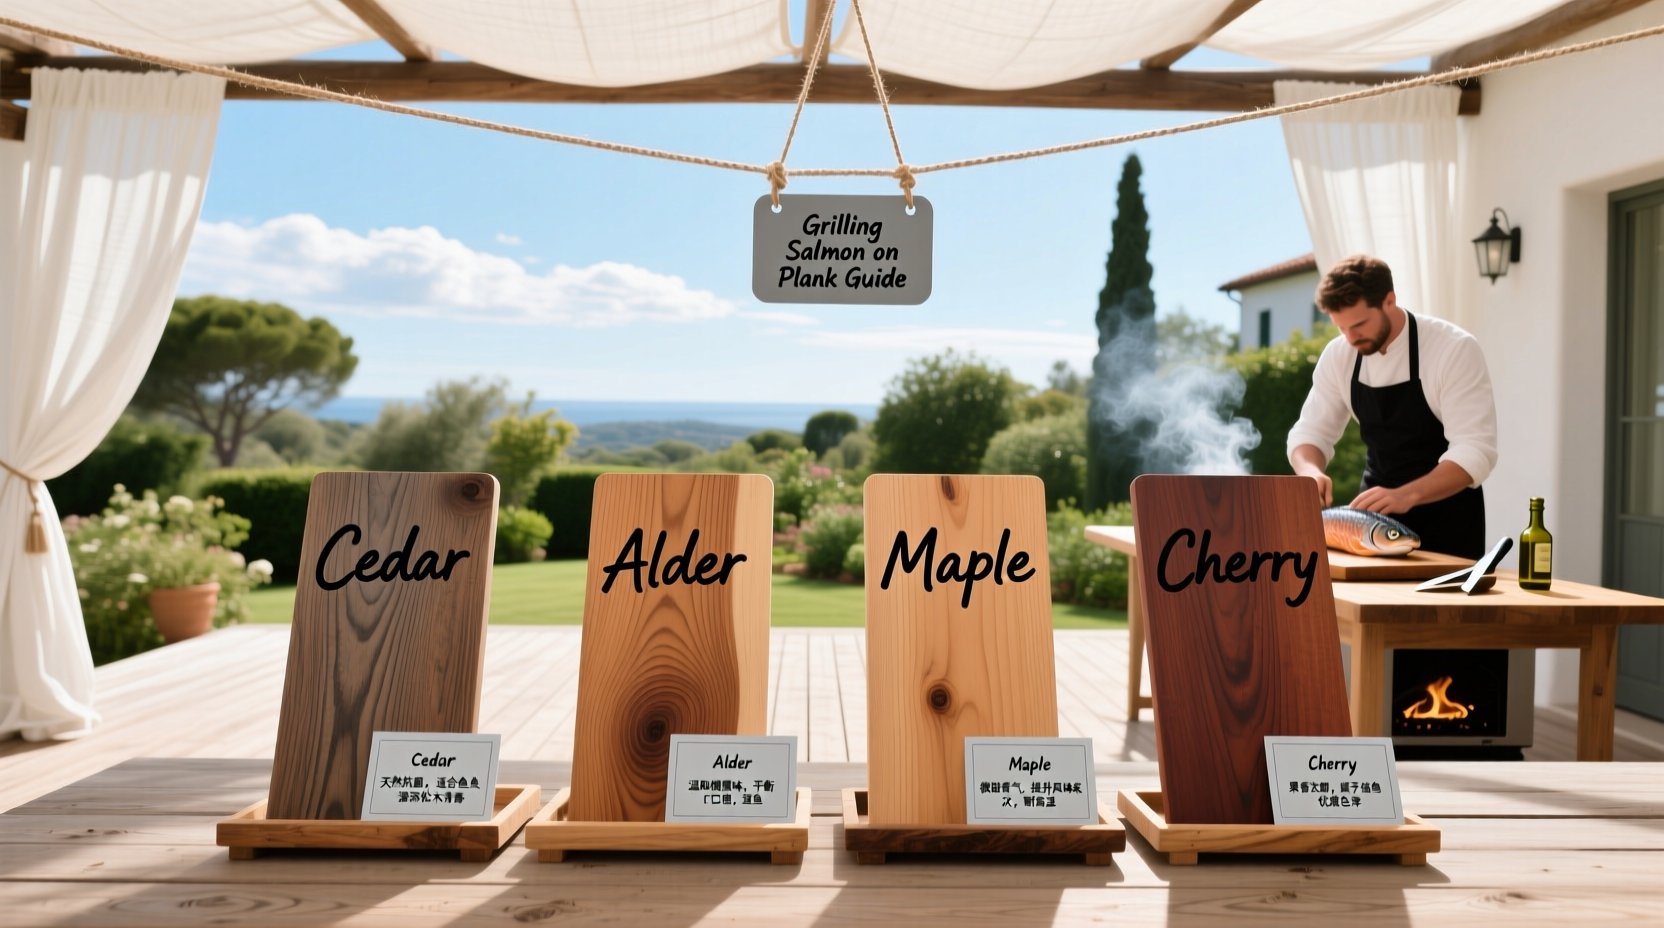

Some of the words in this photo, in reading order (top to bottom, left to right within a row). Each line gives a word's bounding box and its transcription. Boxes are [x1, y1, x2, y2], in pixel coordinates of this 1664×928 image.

[802, 213, 883, 243] Grilling
[786, 239, 864, 260] Salmon
[873, 247, 898, 260] on
[779, 266, 837, 287] Plank
[845, 267, 906, 289] Guide
[316, 524, 470, 590] Cedar
[602, 528, 747, 593] Alder
[881, 528, 1035, 608] Maple
[1157, 528, 1318, 607] Cherry
[412, 752, 456, 767] Cedar
[713, 754, 752, 769] Alder
[1009, 756, 1050, 775] Maple
[1309, 755, 1356, 776] Cherry
